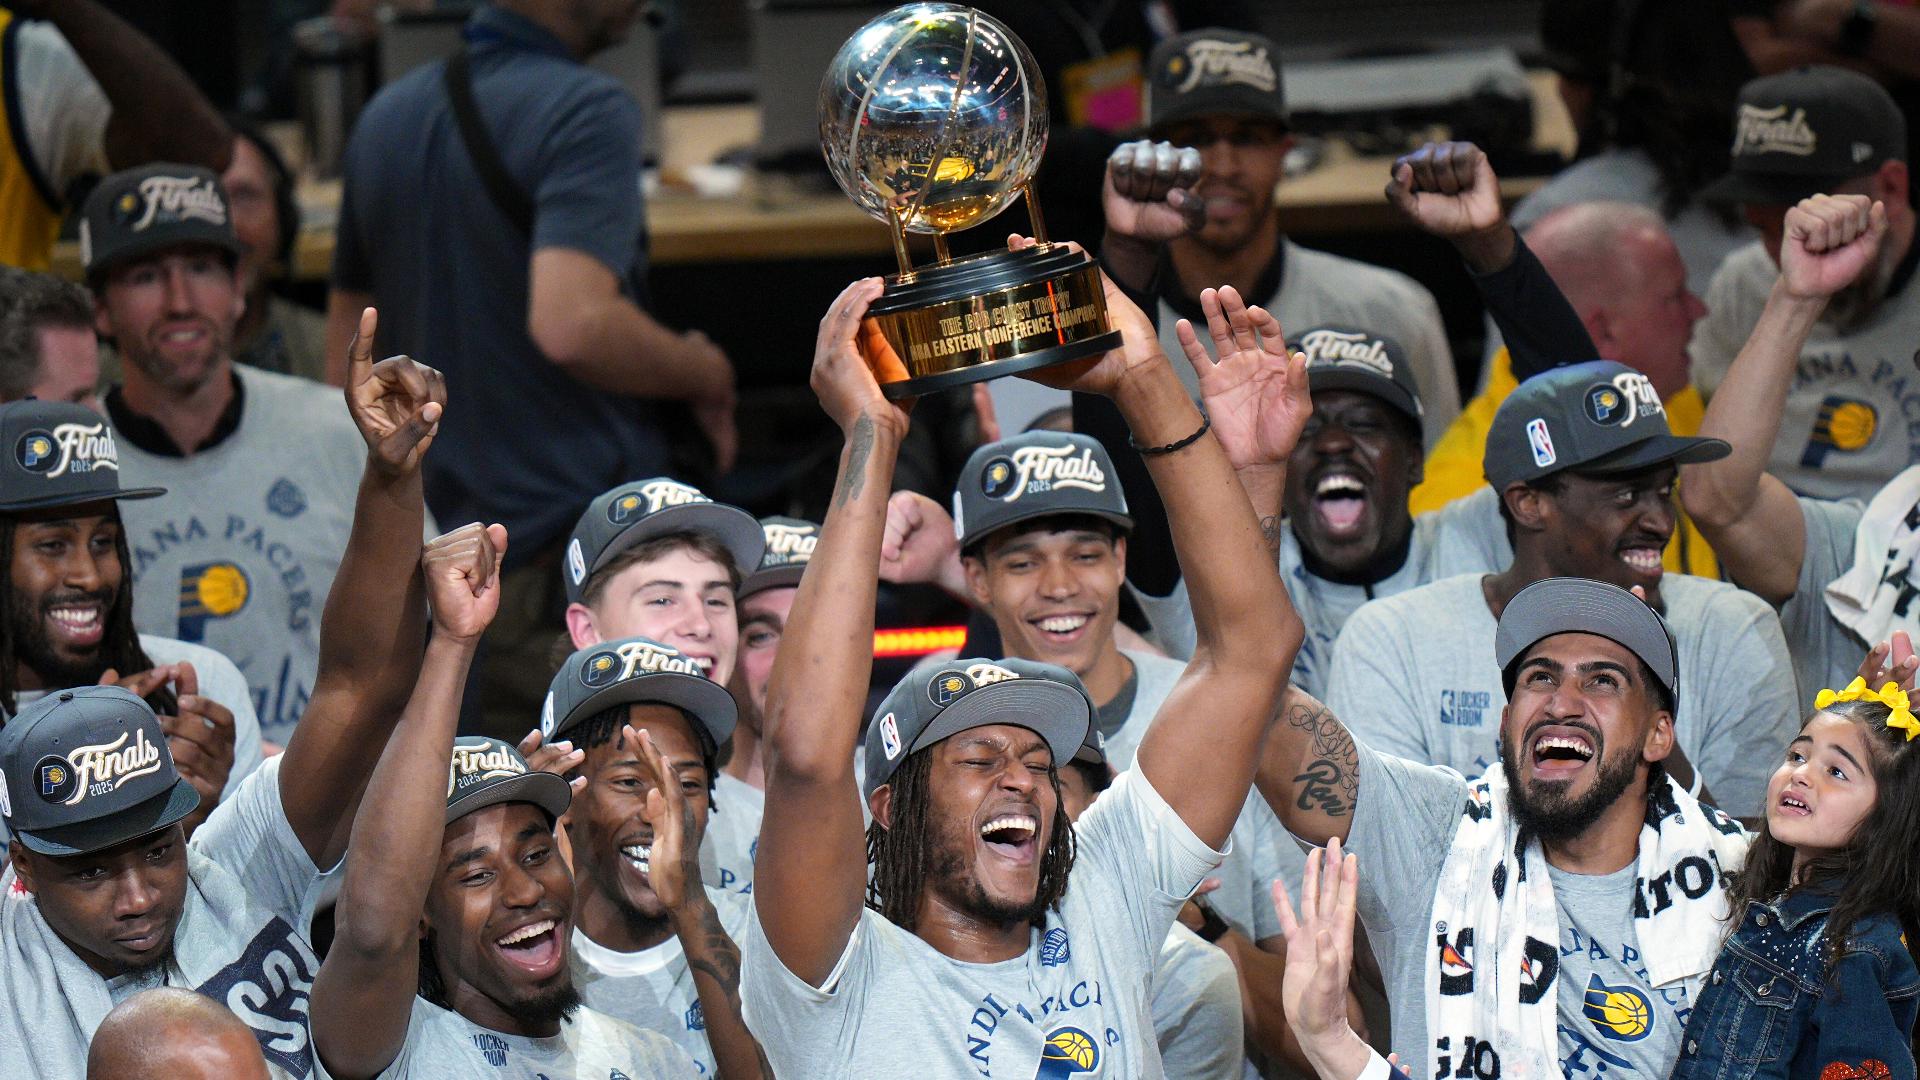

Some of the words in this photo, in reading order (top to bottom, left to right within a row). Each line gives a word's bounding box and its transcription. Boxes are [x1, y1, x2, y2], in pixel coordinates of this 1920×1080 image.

[932, 332, 983, 357] EASTERN
[984, 315, 1053, 346] CONFERENCE
[940, 316, 964, 337] THE
[1003, 444, 1105, 502] Finals
[1028, 480, 1051, 494] 2025
[1457, 690, 1490, 709] LOCKER
[1457, 708, 1482, 727] ROOM
[65, 728, 161, 805] Finals
[89, 780, 114, 797] 2025
[457, 773, 481, 789] 2025
